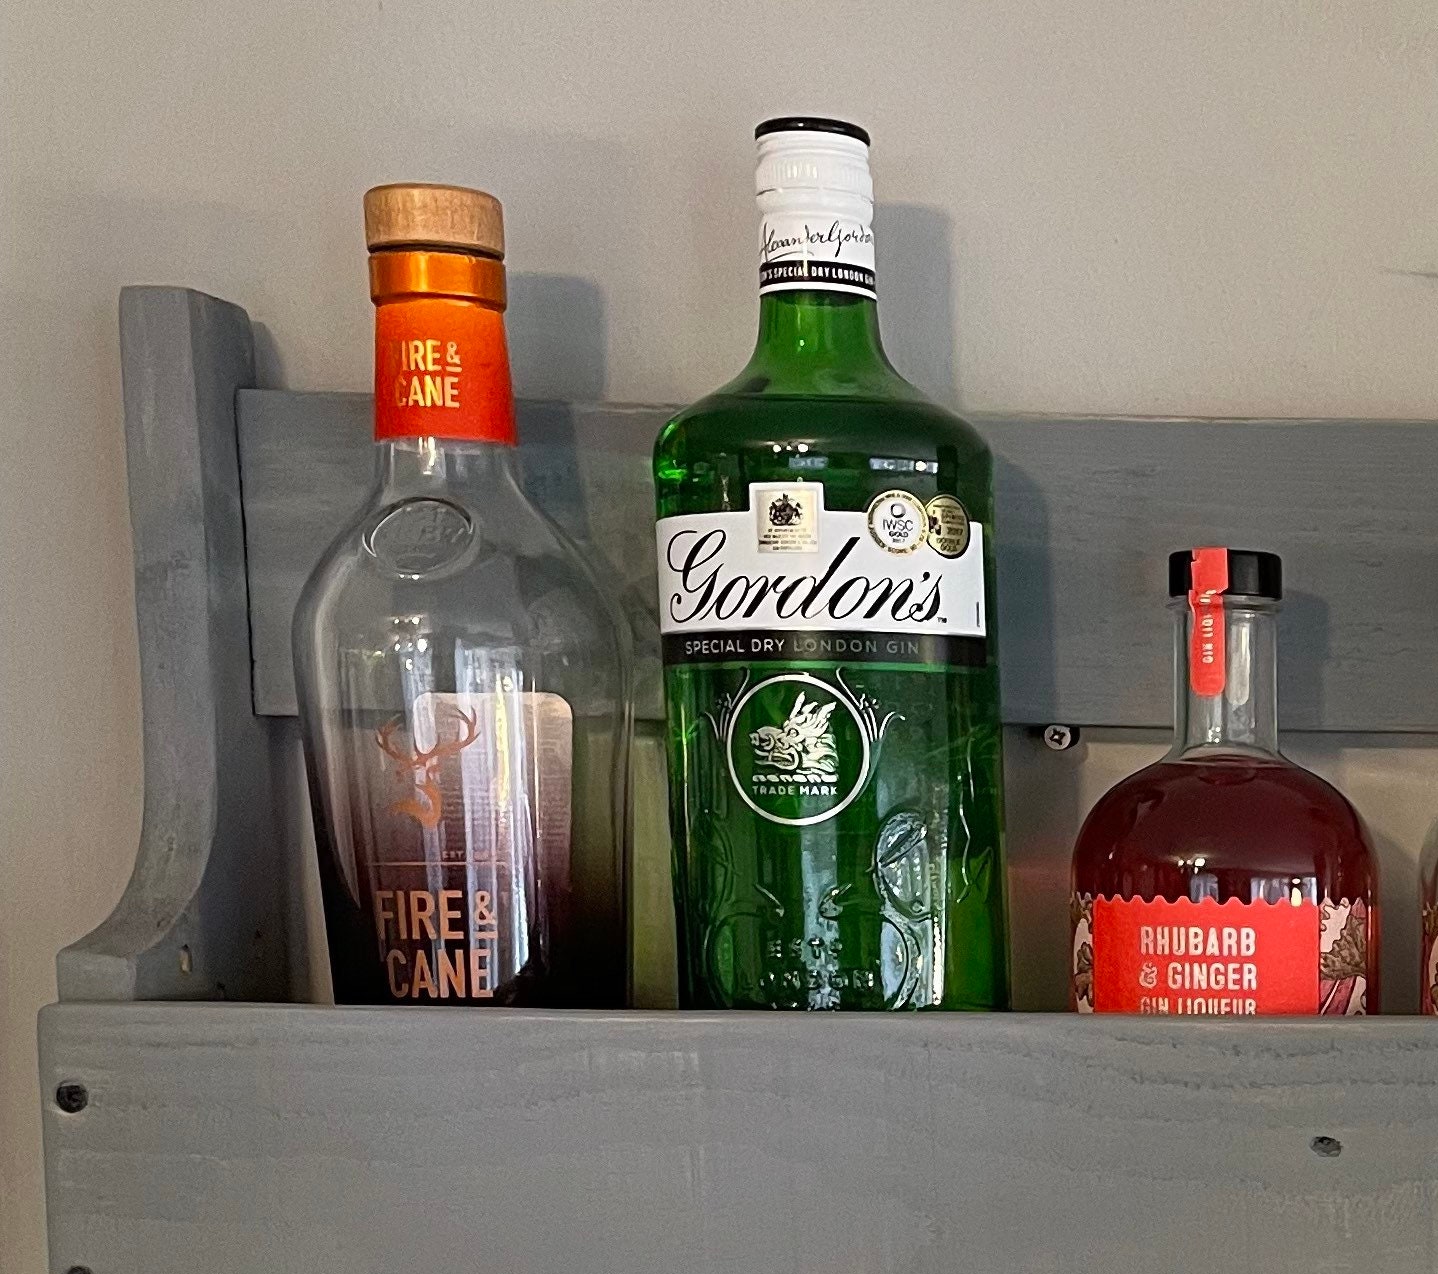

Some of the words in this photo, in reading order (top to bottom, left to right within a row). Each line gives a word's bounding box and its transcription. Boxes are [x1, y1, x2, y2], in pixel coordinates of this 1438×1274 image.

[773, 266, 808, 279] SPECIAL
[811, 266, 830, 278] DRY
[398, 338, 442, 371] IRE
[446, 341, 462, 368] &
[396, 375, 460, 408] CANE
[882, 519, 914, 532] IWSC
[667, 529, 943, 624] Gordon's
[685, 639, 745, 655] SPECIAL
[751, 638, 785, 653] DRY
[793, 639, 877, 653] LONDON
[886, 640, 919, 655] GIN
[752, 785, 796, 797] TRADE
[799, 785, 838, 796] MARK
[375, 890, 464, 940] FIRE
[474, 890, 498, 932] &
[1140, 926, 1257, 957] RHUBARB
[386, 948, 494, 998] CANE
[1138, 963, 1158, 990] &
[1167, 962, 1257, 990] GINGER
